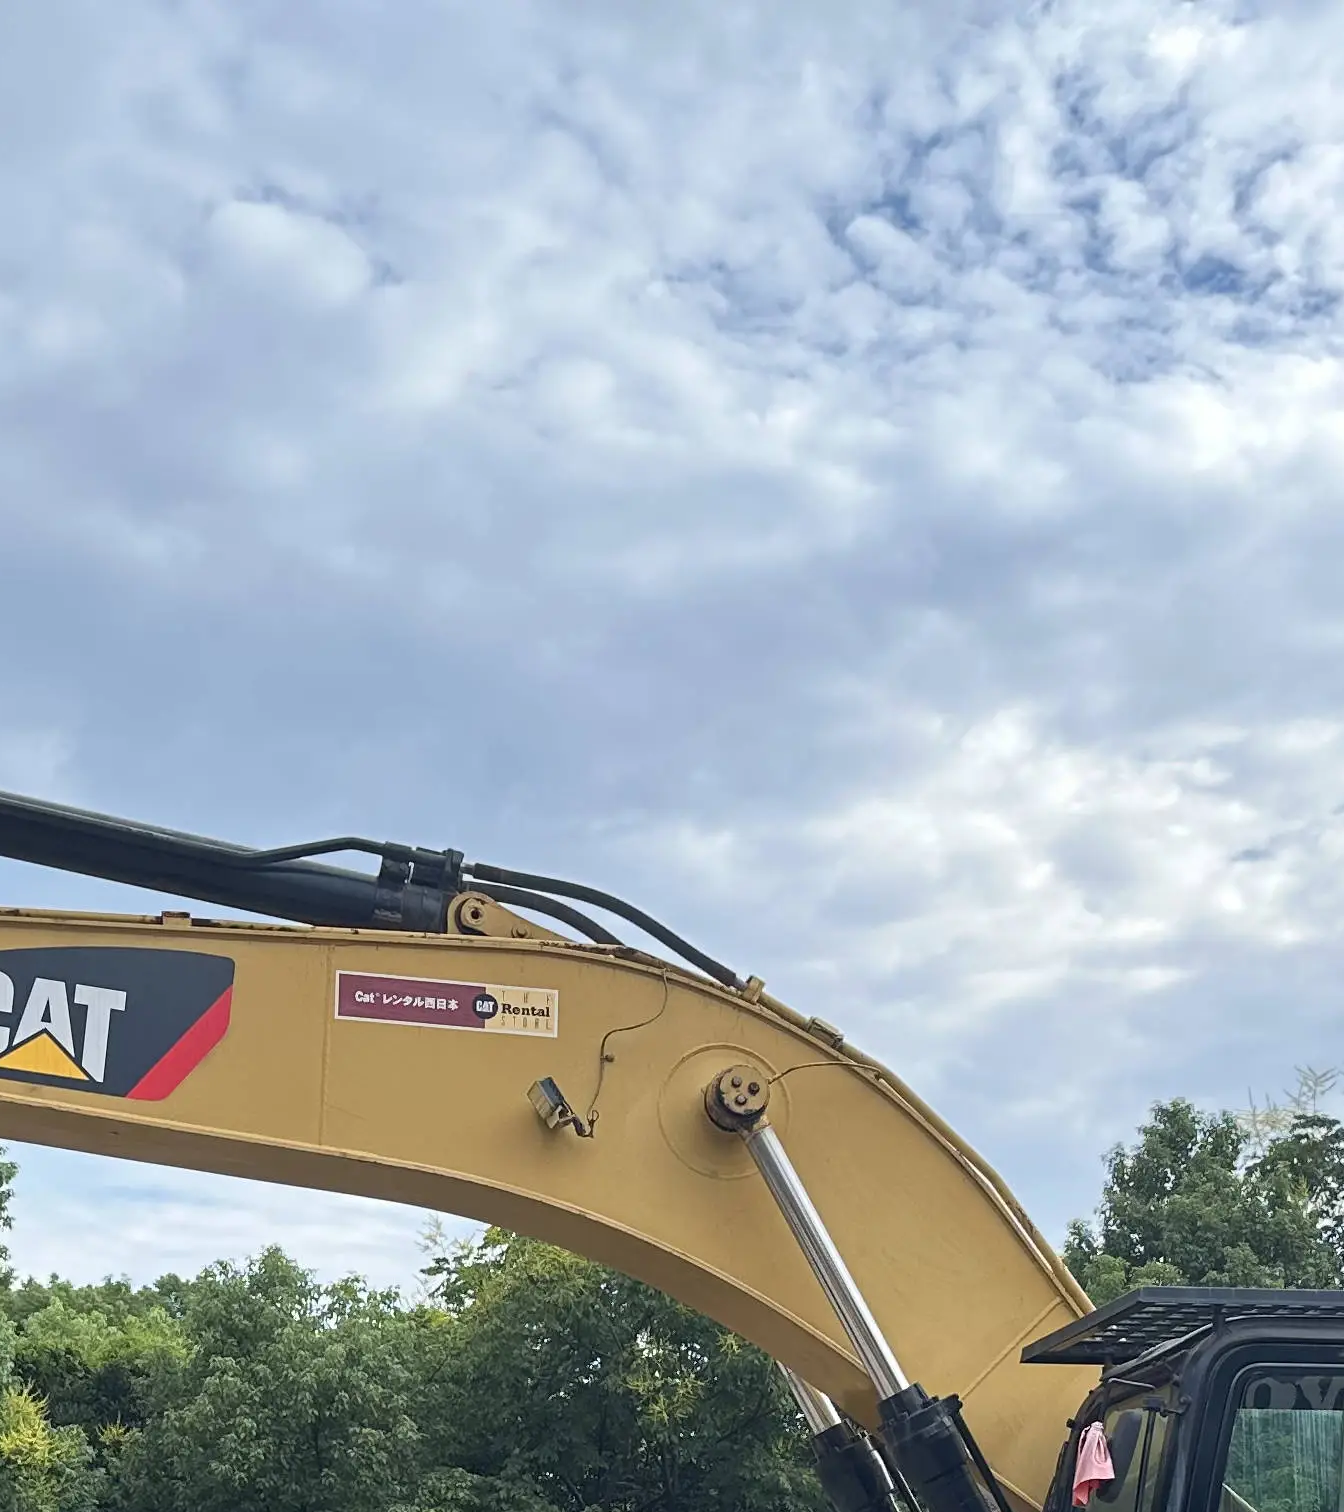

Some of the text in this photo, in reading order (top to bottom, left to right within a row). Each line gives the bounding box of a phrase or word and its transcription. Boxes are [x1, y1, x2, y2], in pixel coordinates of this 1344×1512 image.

[382, 993, 459, 1012] レンタル西日本
[475, 1000, 495, 1013] CAT
[500, 1002, 551, 1018] Rental
